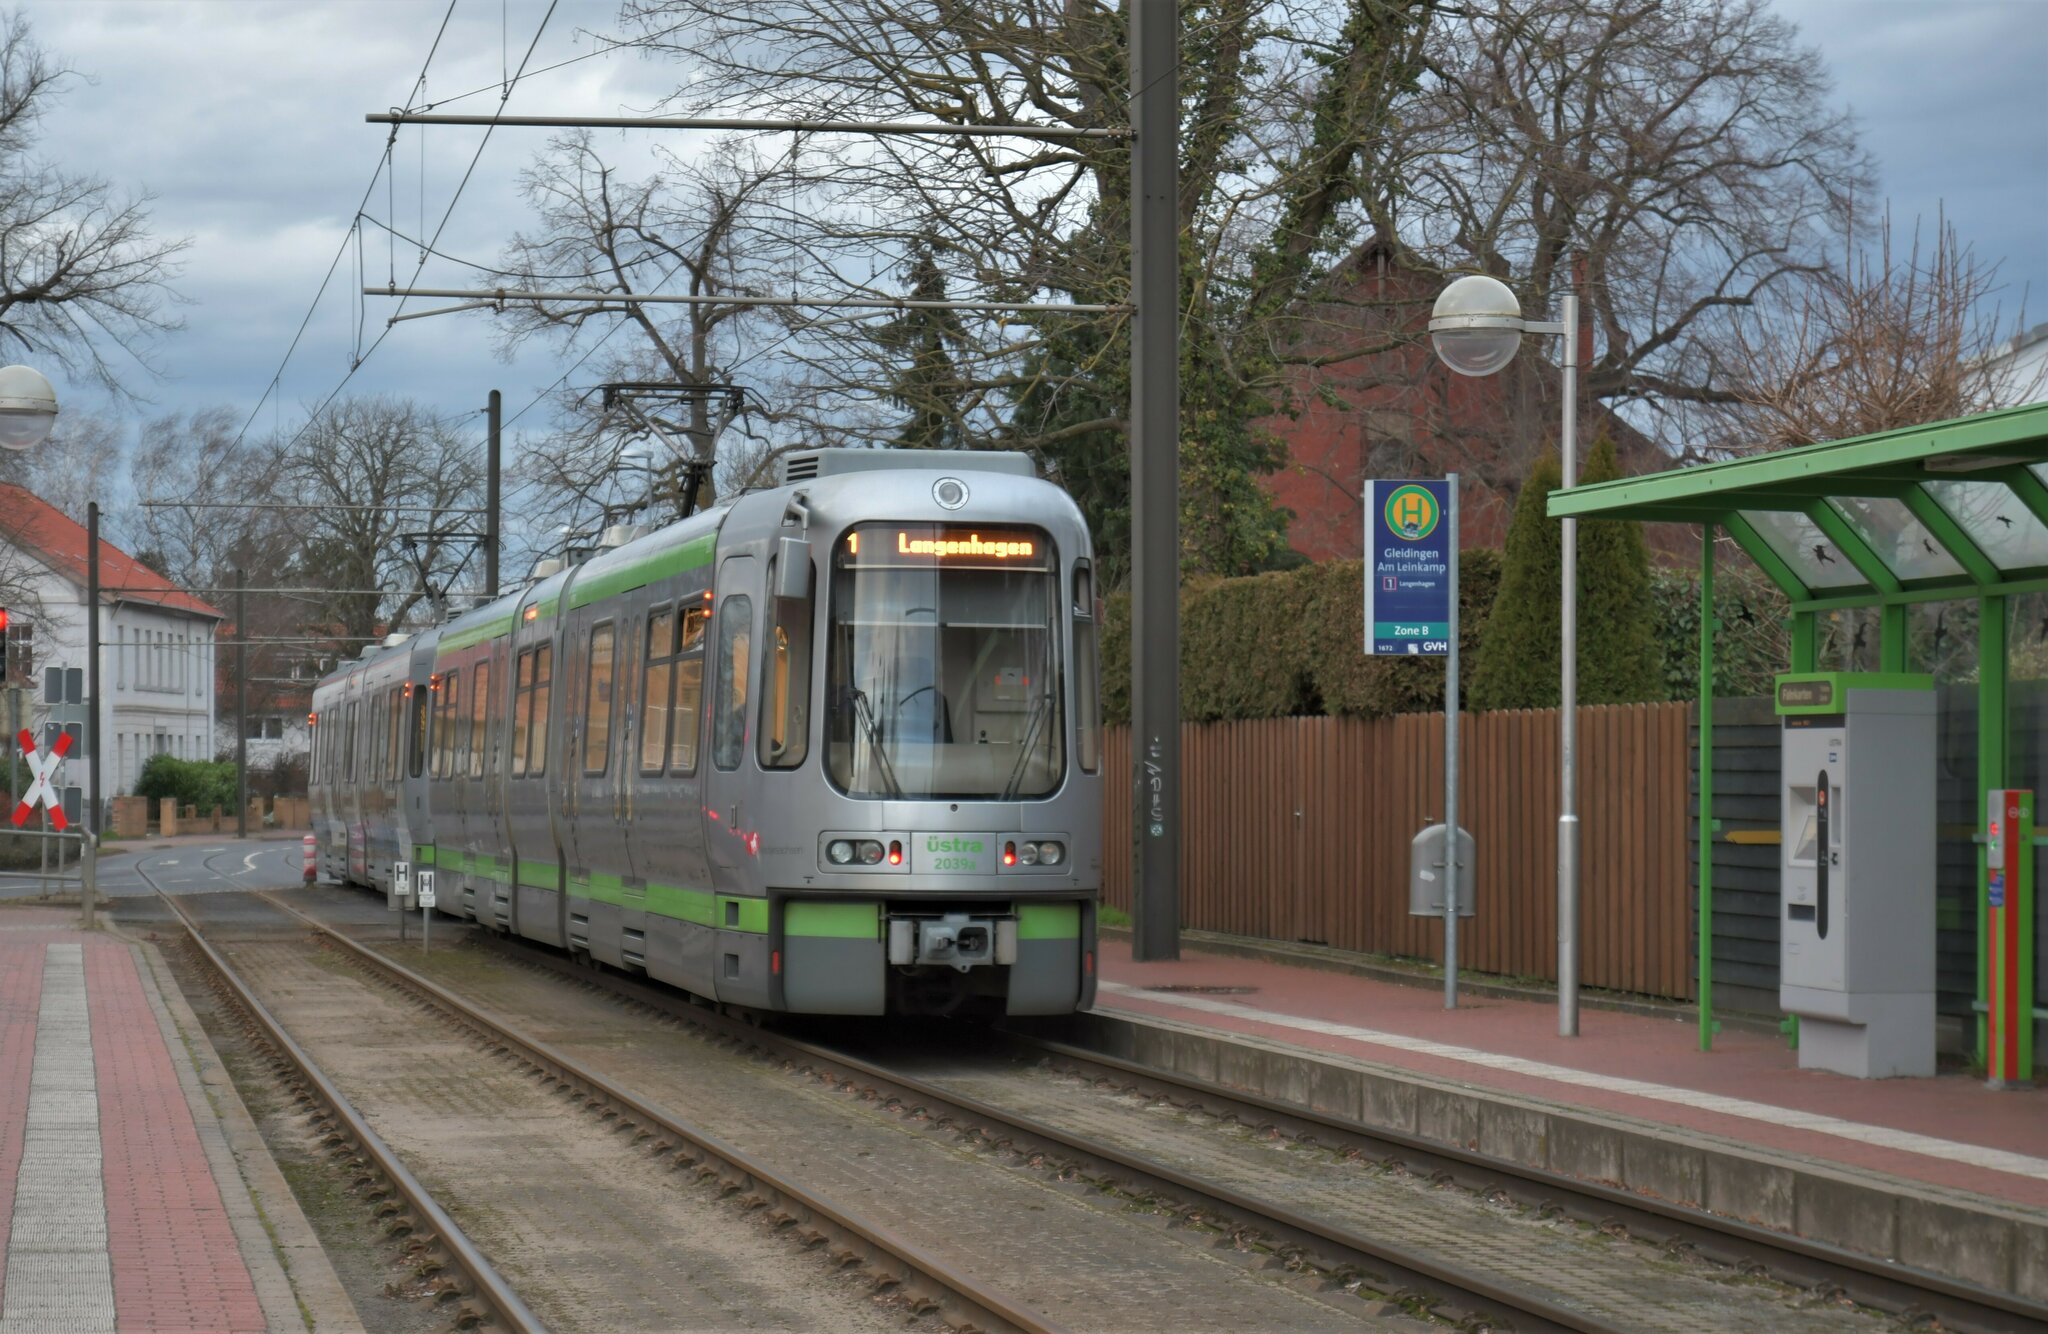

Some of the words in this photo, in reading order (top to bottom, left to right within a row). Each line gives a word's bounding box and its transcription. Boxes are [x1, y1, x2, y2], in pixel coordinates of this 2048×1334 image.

[1401, 497, 1423, 529] H
[846, 532, 857, 554] 1
[898, 532, 1033, 558] Langenhagen
[1384, 548, 1439, 561] Gleidingen
[1377, 562, 1395, 572] Am
[1397, 562, 1446, 575] Leinkamp
[1394, 625, 1420, 636] Zone
[1422, 625, 1429, 636] B
[1423, 641, 1448, 652] GVH
[396, 864, 408, 882] H
[420, 874, 433, 893] H
